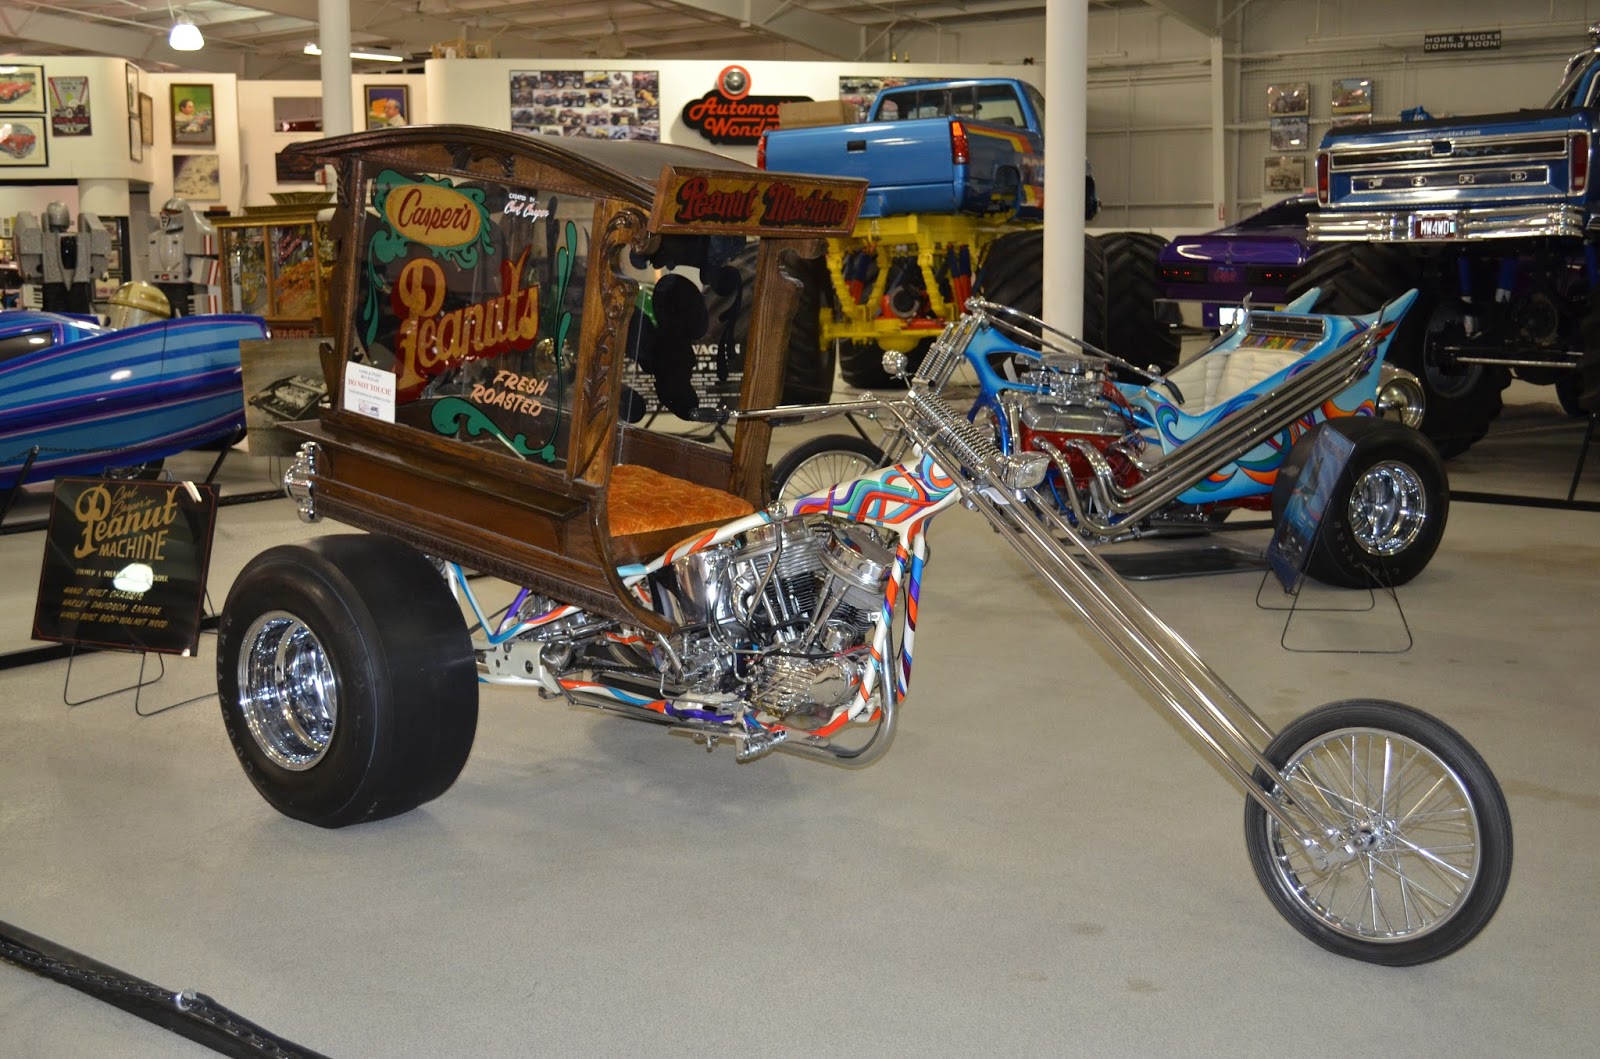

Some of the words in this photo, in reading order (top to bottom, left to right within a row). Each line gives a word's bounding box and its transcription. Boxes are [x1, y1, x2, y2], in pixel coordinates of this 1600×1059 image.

[1425, 42, 1464, 50] COMING
[1467, 40, 1500, 48] SOON!
[1459, 34, 1500, 42] TRUCKS
[1408, 130, 1481, 141] www.bigfoot4x4.com
[508, 193, 527, 201] CREATED
[675, 176, 760, 224] Peanut
[758, 182, 850, 228] Machine
[398, 188, 472, 236] Casper's
[393, 244, 540, 396] Peanuts
[348, 379, 357, 387] DO
[357, 381, 369, 389] NOT
[369, 385, 392, 396] TOUCH!
[493, 370, 549, 397] FRESH
[470, 383, 543, 417] ROASTED
[74, 483, 179, 559] Peanut
[98, 530, 169, 561] MACHINE
[63, 586, 83, 595] HAND
[86, 588, 108, 598] BUILT
[109, 590, 145, 601] CHASSIS
[62, 599, 89, 609] HARLEY
[90, 601, 129, 612] DAVIDSON
[130, 605, 163, 616] ENGINE
